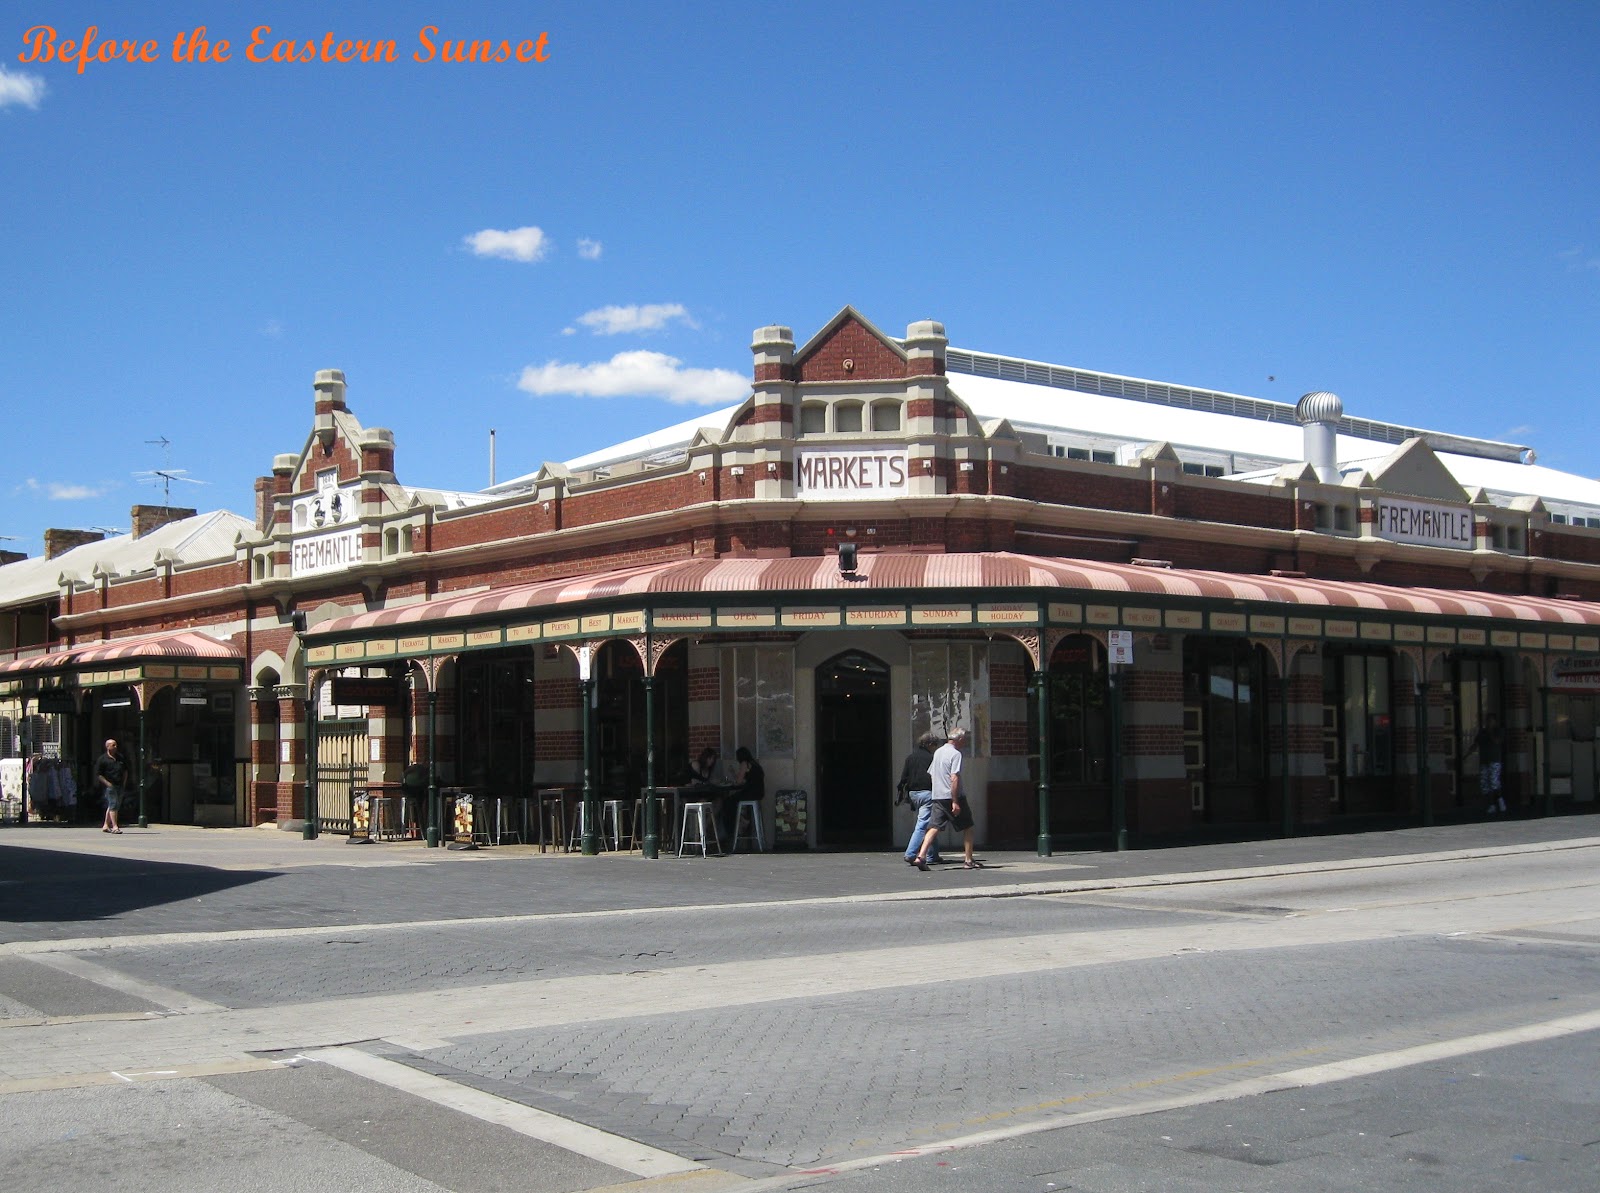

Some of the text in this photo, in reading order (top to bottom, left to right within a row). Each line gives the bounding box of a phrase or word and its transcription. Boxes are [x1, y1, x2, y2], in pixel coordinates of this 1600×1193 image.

[797, 455, 905, 490] MARKETS
[1379, 504, 1469, 542] FREMANTLE
[294, 533, 363, 572] FREMANTLE
[661, 608, 1024, 621] MARKET OPEN FRIDAY SATURDAY SUNDAY HOLIDAY
[1056, 607, 1074, 618] TAKE
[437, 636, 458, 645] MARKETS
[588, 618, 602, 627] BEST
[617, 615, 640, 625] MARKET
